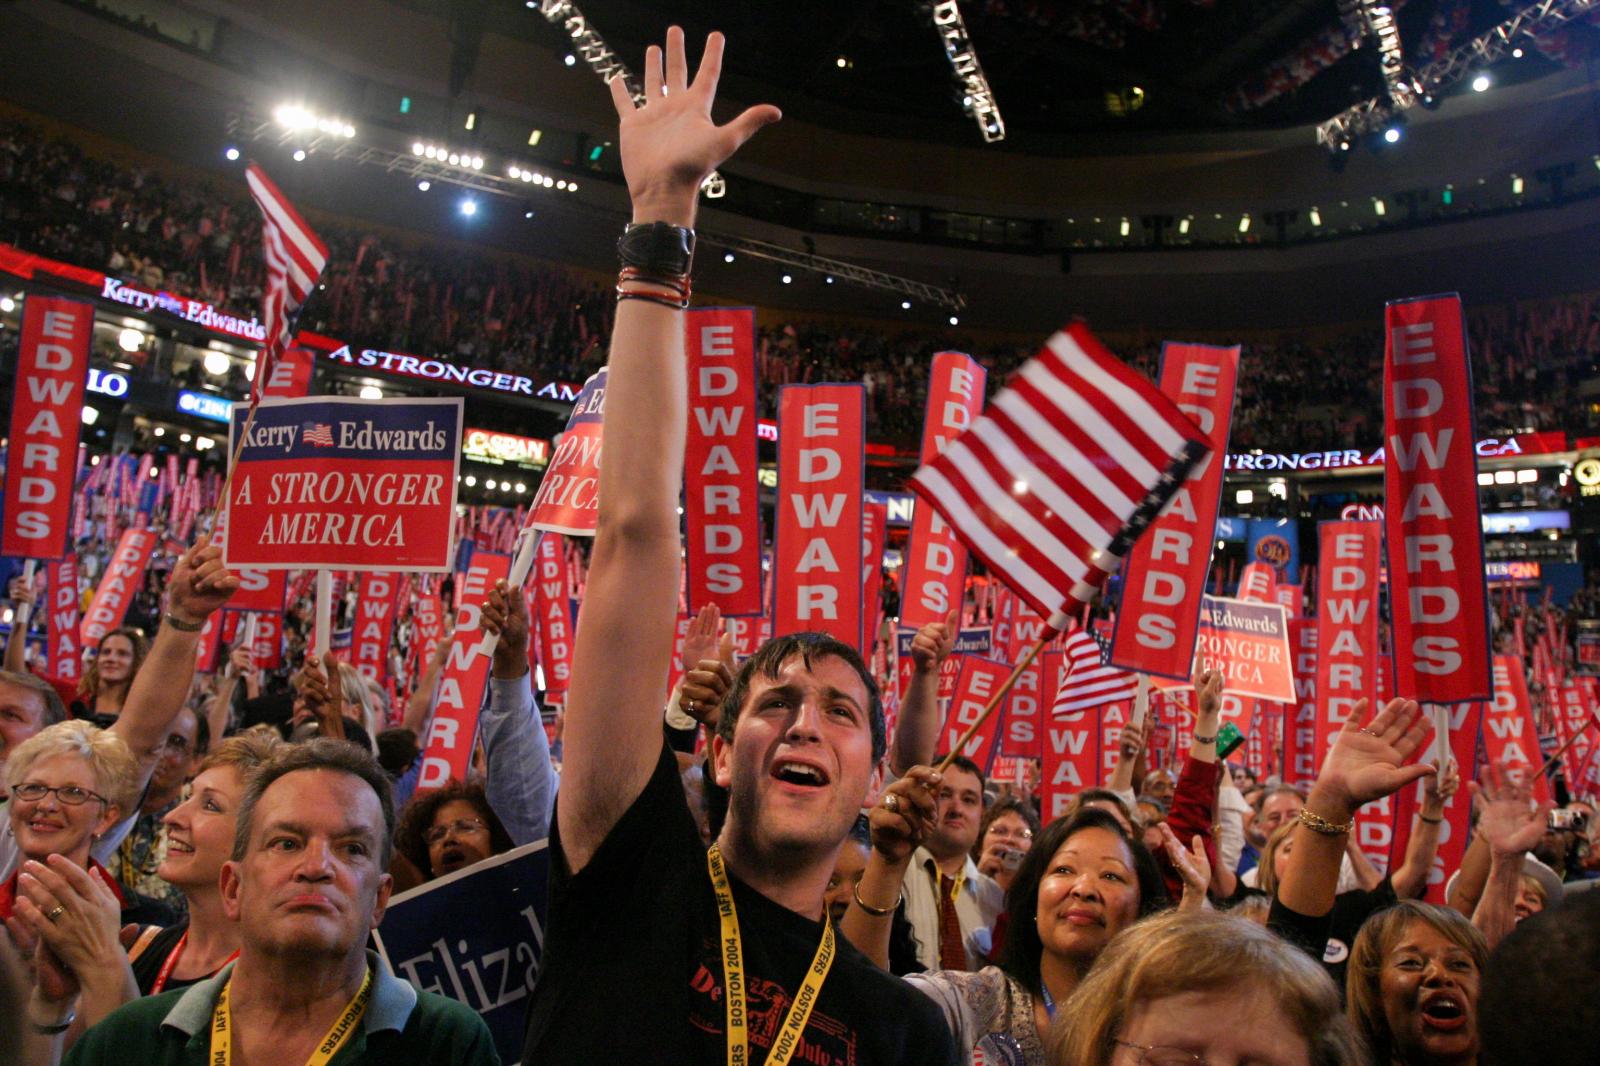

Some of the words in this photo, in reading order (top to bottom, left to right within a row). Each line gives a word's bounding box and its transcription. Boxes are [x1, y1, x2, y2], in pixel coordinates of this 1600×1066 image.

[101, 276, 159, 312] Kerry
[185, 300, 266, 340] Edwards
[329, 345, 354, 363] A
[358, 349, 534, 394] STRONGER
[15, 310, 75, 539] EDWARDS
[241, 421, 298, 453] Kerry
[338, 421, 446, 451] Edwards
[693, 325, 745, 594] EDWARDS
[235, 475, 252, 506] A
[267, 471, 444, 506] STRONGER
[1390, 322, 1463, 676] EDWARDS
[258, 512, 406, 547] AMERICA
[85, 533, 148, 639] EDWARDS
[541, 540, 570, 680] EDWARDS
[1212, 609, 1278, 634] Edwards
[718, 892, 733, 917] IAFF
[725, 938, 740, 968] 2004
[215, 1010, 226, 1033] IAFF
[731, 972, 743, 1027] BOSTON
[788, 983, 815, 1031] BOSTON
[320, 1004, 362, 1055] FIGHTERS
[773, 1030, 796, 1063] 2004
